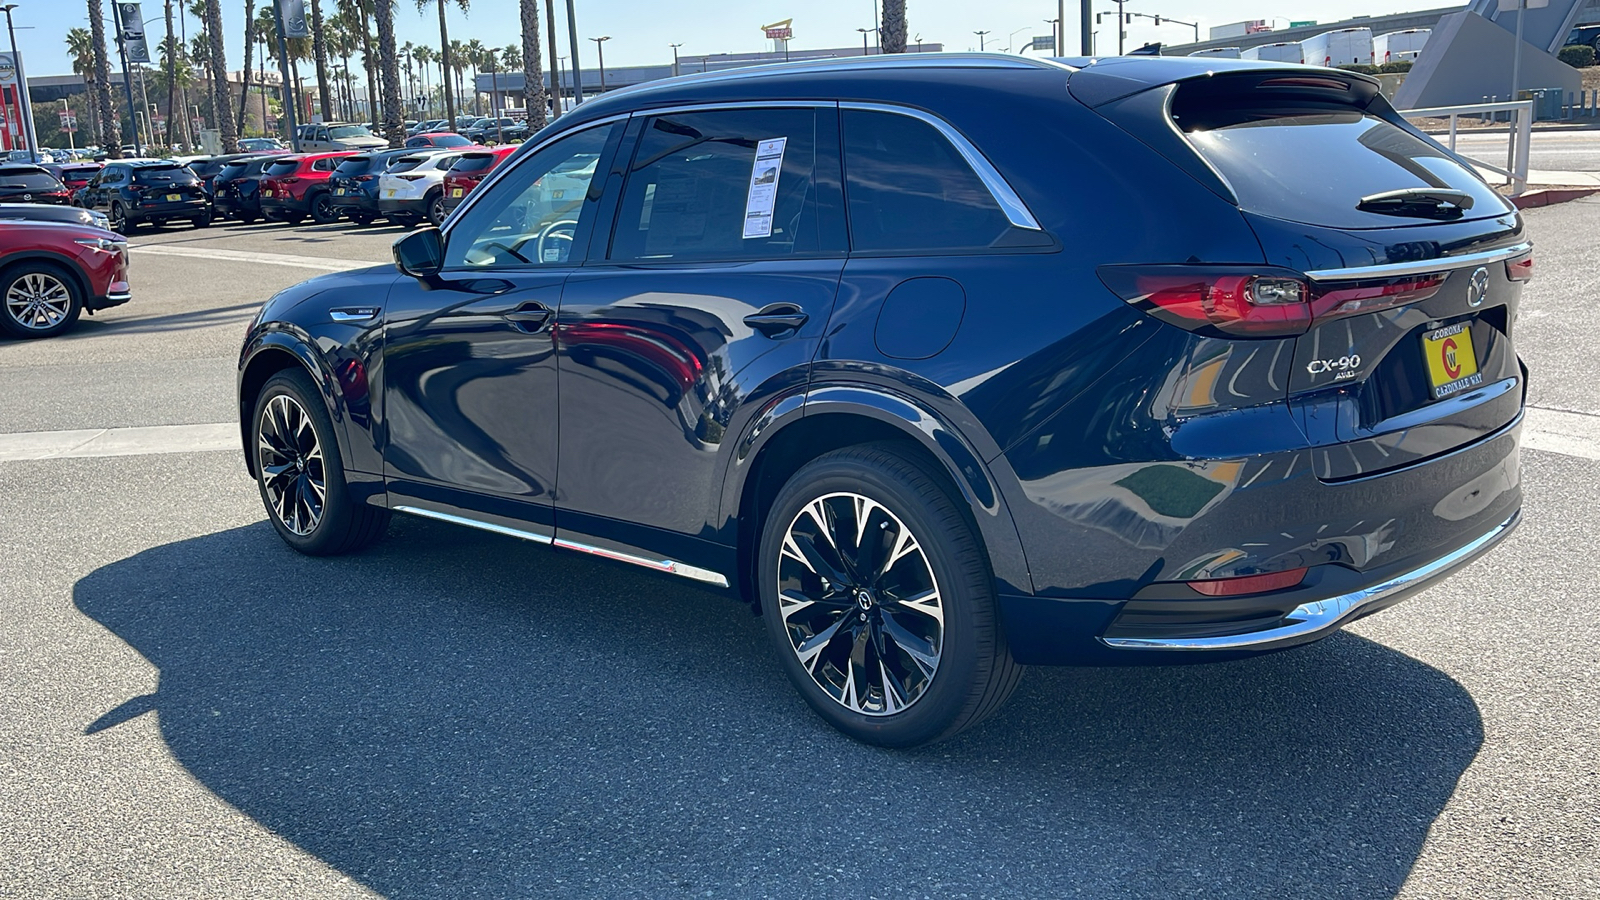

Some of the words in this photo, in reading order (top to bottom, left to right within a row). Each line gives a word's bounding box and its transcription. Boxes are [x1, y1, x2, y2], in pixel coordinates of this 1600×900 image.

[1434, 324, 1463, 340] CORONA
[1306, 354, 1361, 374] CX-90
[1334, 370, 1355, 380] AWD
[1435, 378, 1469, 398] CARDINALE
[1470, 373, 1483, 386] WAY
